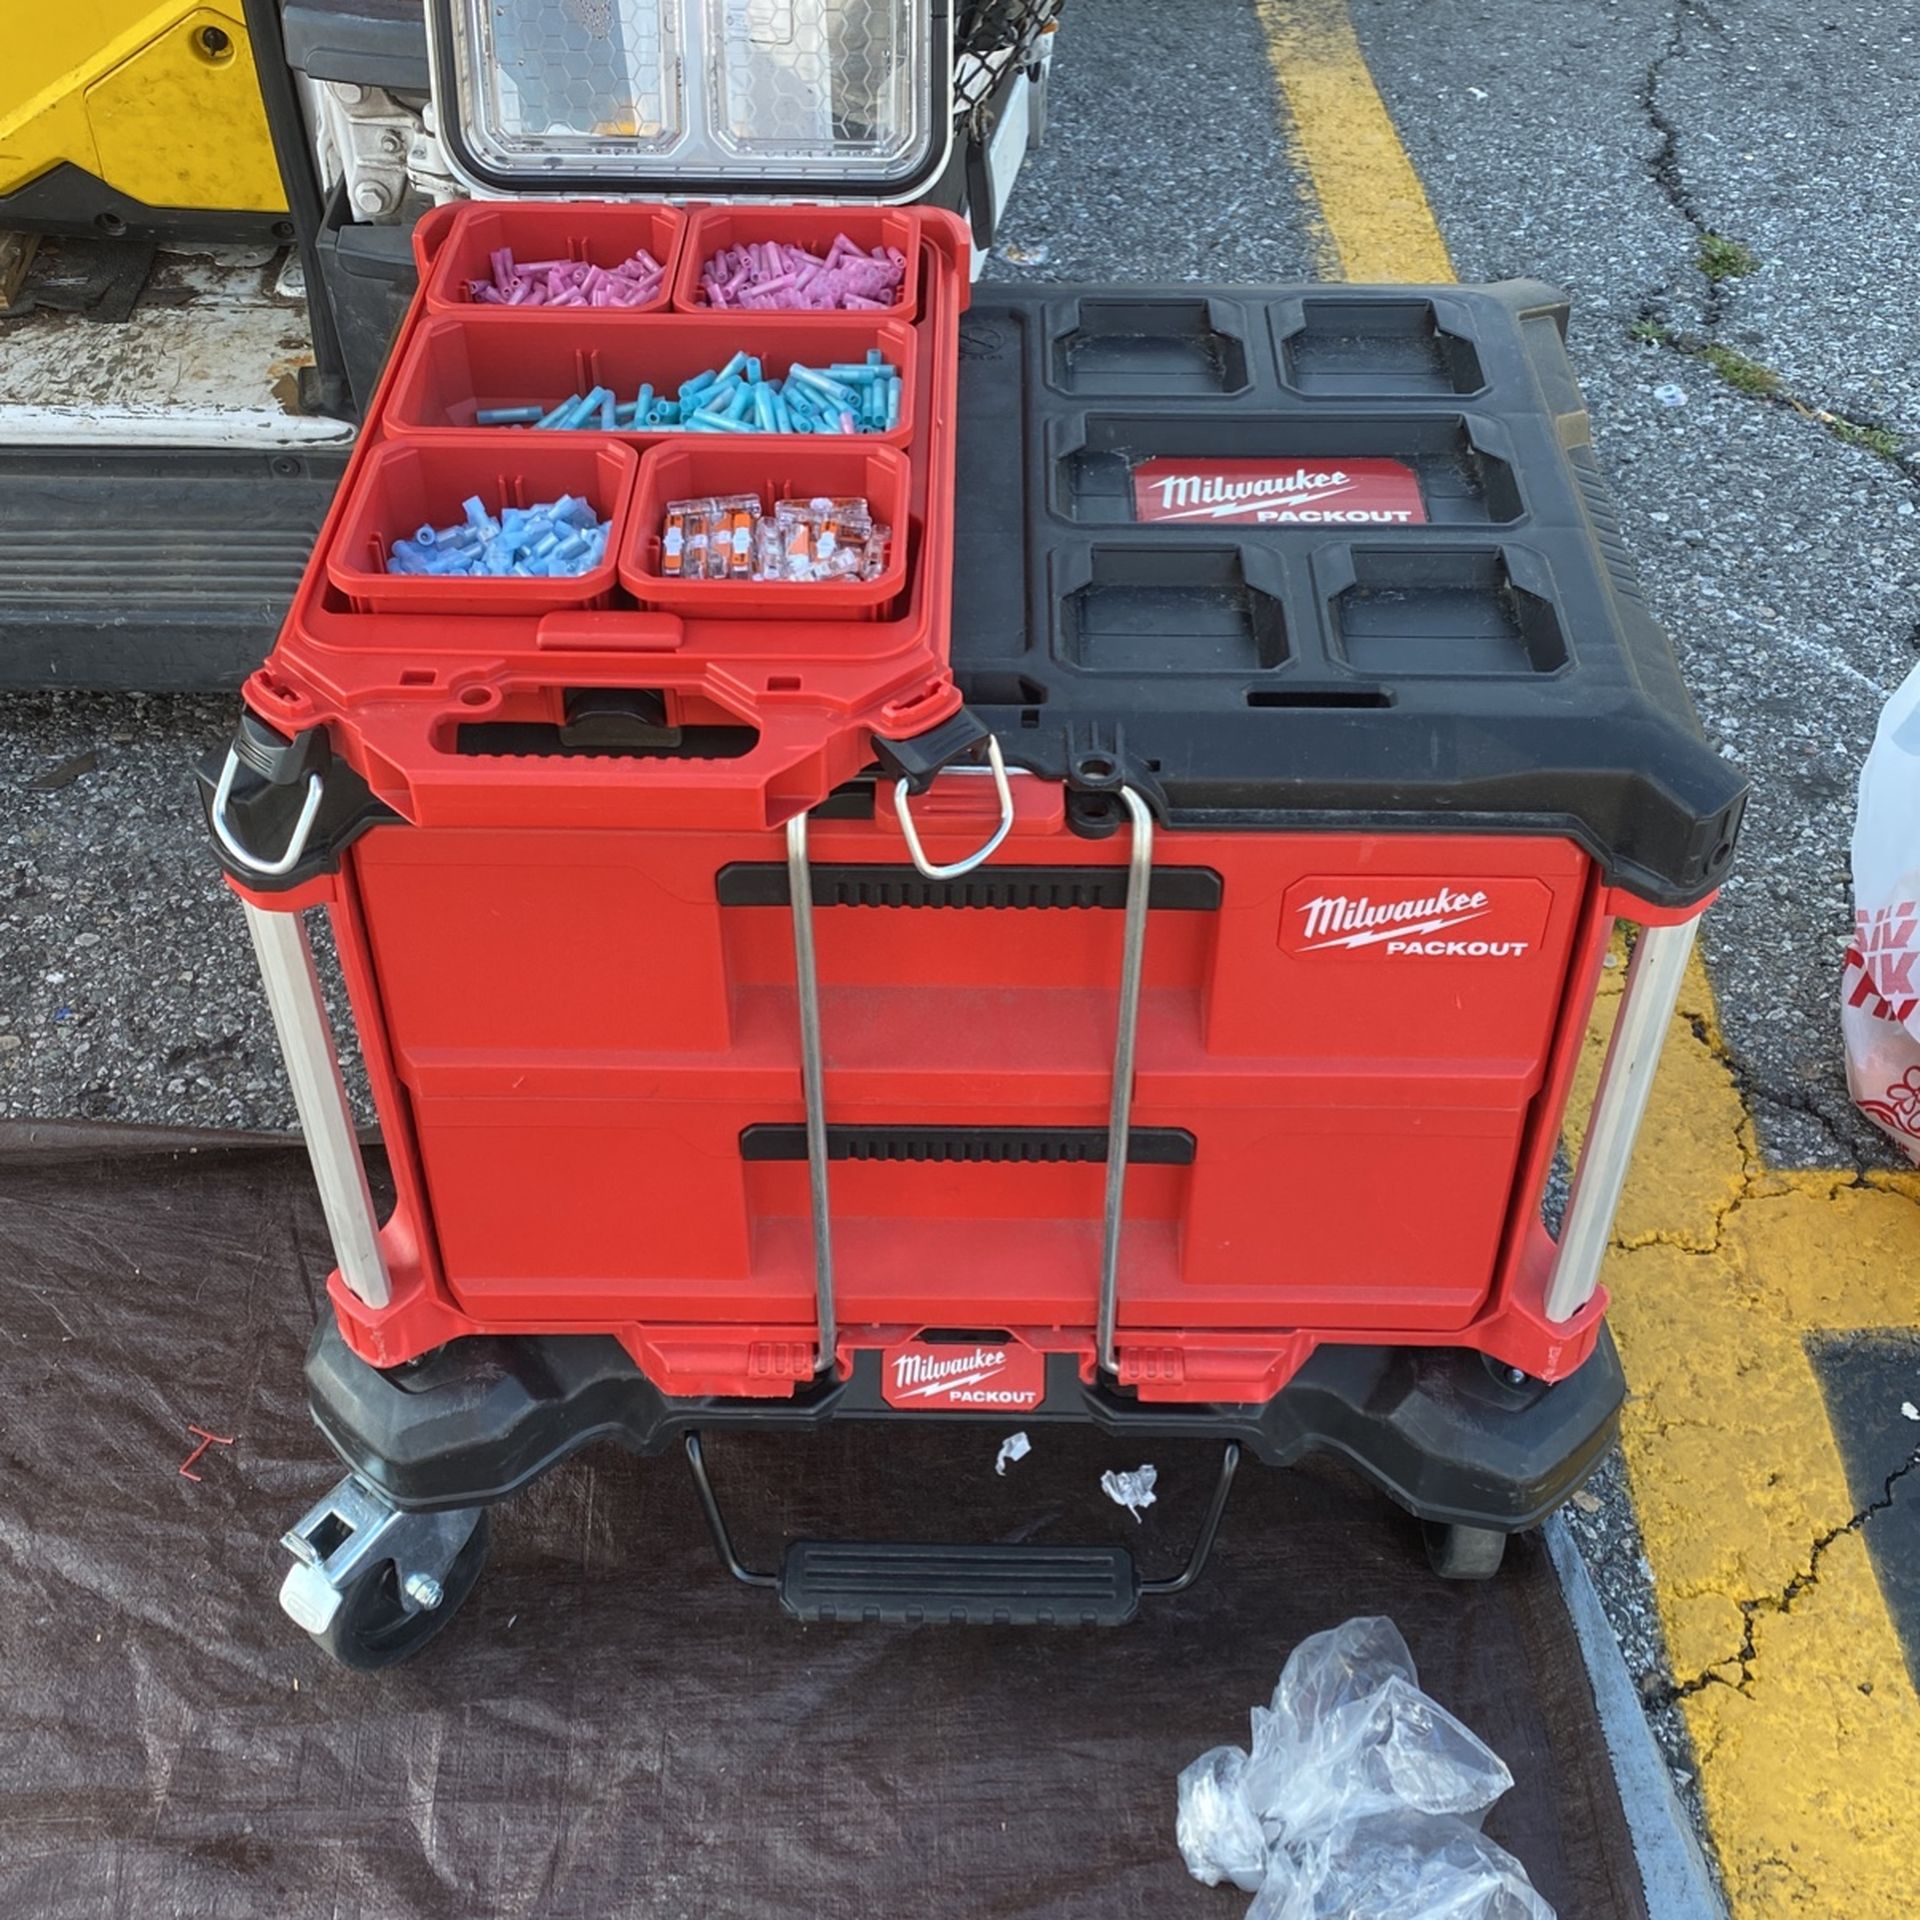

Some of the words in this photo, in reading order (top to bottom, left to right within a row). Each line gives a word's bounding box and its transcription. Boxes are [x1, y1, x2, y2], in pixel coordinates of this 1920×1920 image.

[1149, 469, 1349, 509] Milwaukee
[1257, 510, 1412, 523] PACKOUT
[1296, 887, 1489, 938] Milwaukee
[1386, 941, 1528, 957] PACKOUT
[891, 1348, 1007, 1388] Milwaukee
[950, 1391, 1036, 1404] PACKOUT
